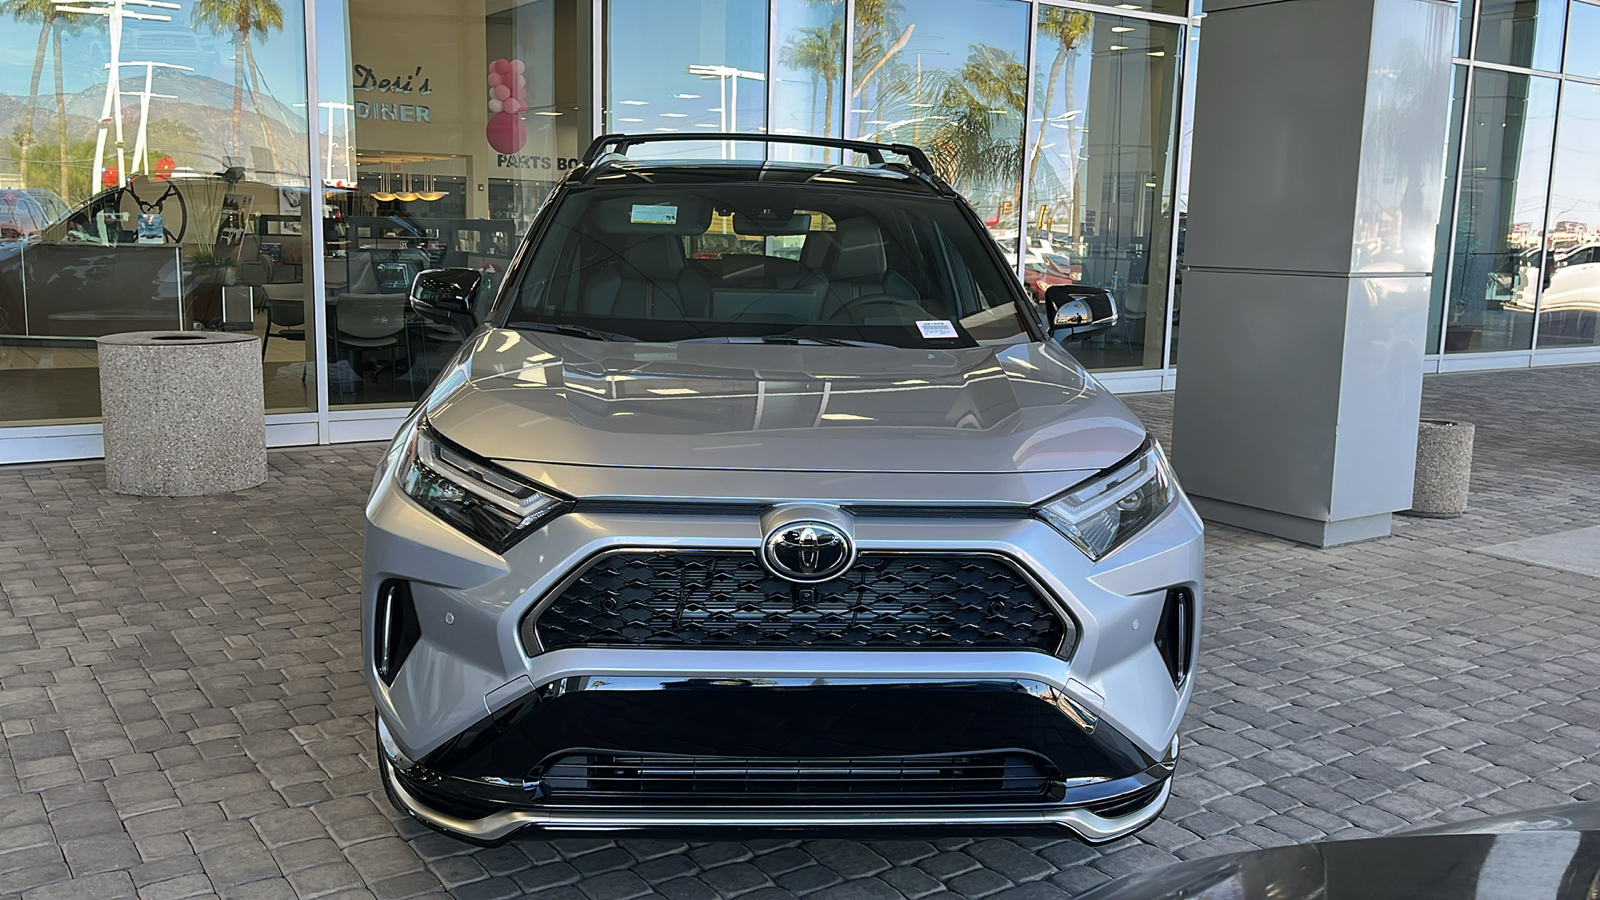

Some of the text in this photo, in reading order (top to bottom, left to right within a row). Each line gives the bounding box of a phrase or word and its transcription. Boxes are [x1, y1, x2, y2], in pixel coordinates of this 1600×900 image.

[353, 64, 432, 95] Desi's
[355, 101, 432, 124] DINER
[497, 154, 552, 170] PARTS
